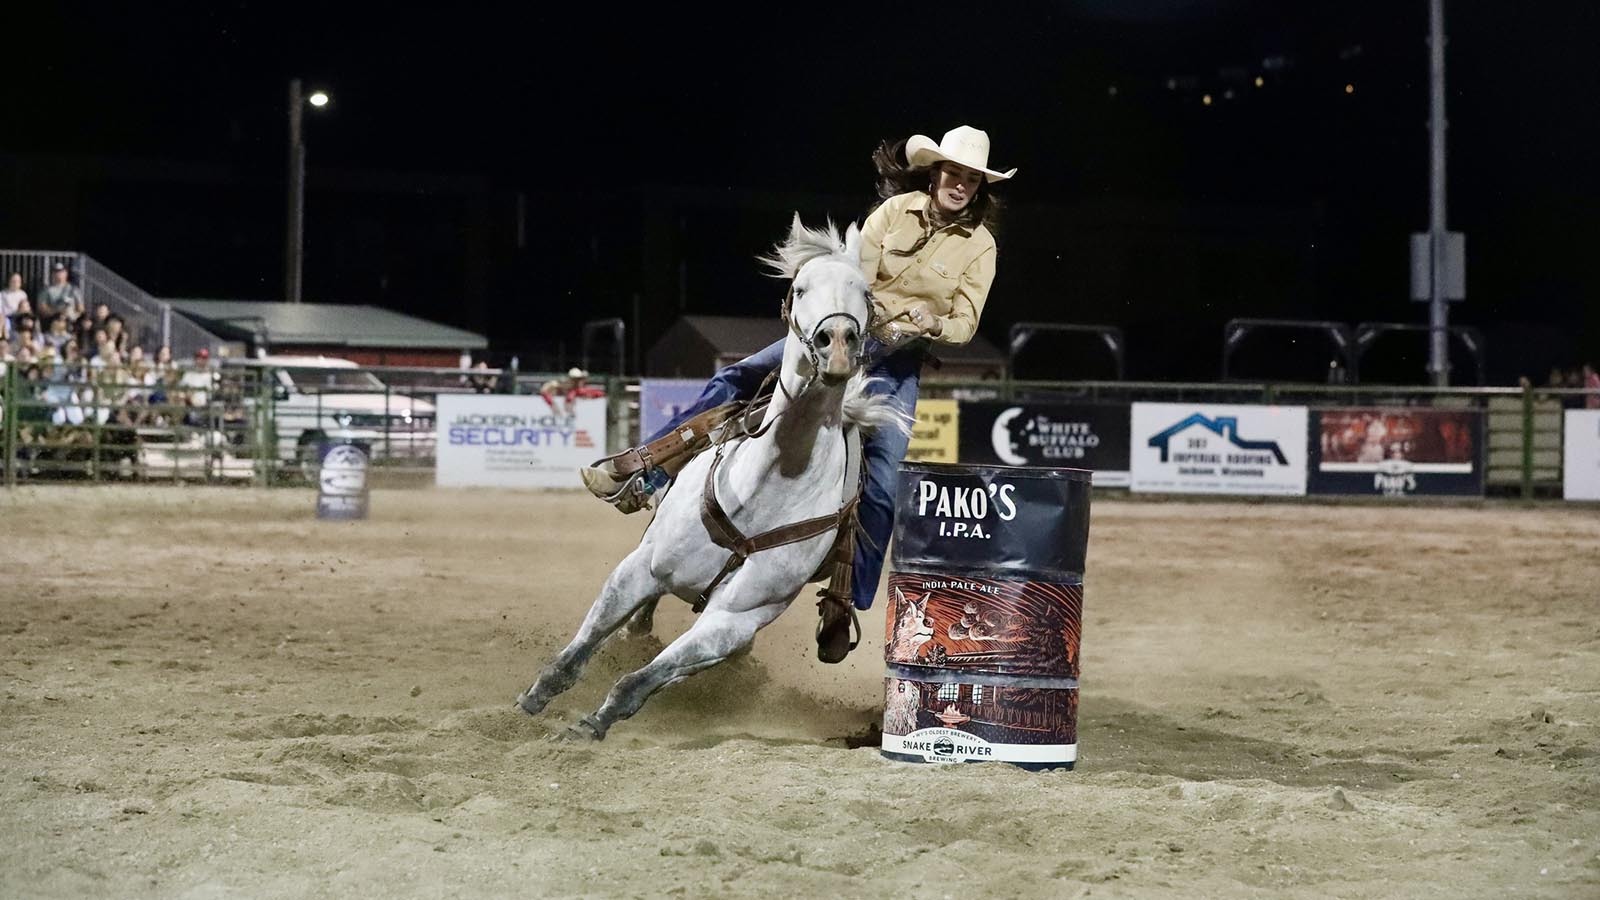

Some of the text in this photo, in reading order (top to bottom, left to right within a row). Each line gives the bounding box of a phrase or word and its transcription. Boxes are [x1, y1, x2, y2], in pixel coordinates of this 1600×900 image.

[449, 414, 576, 427] JACKSON HOLE
[1038, 422, 1089, 434] WHITE
[448, 427, 573, 446] SECURITY
[1028, 434, 1100, 447] BUFFALO
[1042, 446, 1085, 458] CLUB
[1227, 454, 1272, 465] ROOFING
[918, 480, 1018, 521] PAKO'S
[938, 521, 992, 540] I.P.A.
[922, 581, 1001, 595] INDIA PALE ALE
[950, 731, 977, 742] BREWERY
[902, 740, 992, 756] SNAKE RIVER
[929, 755, 957, 763] BREWING
